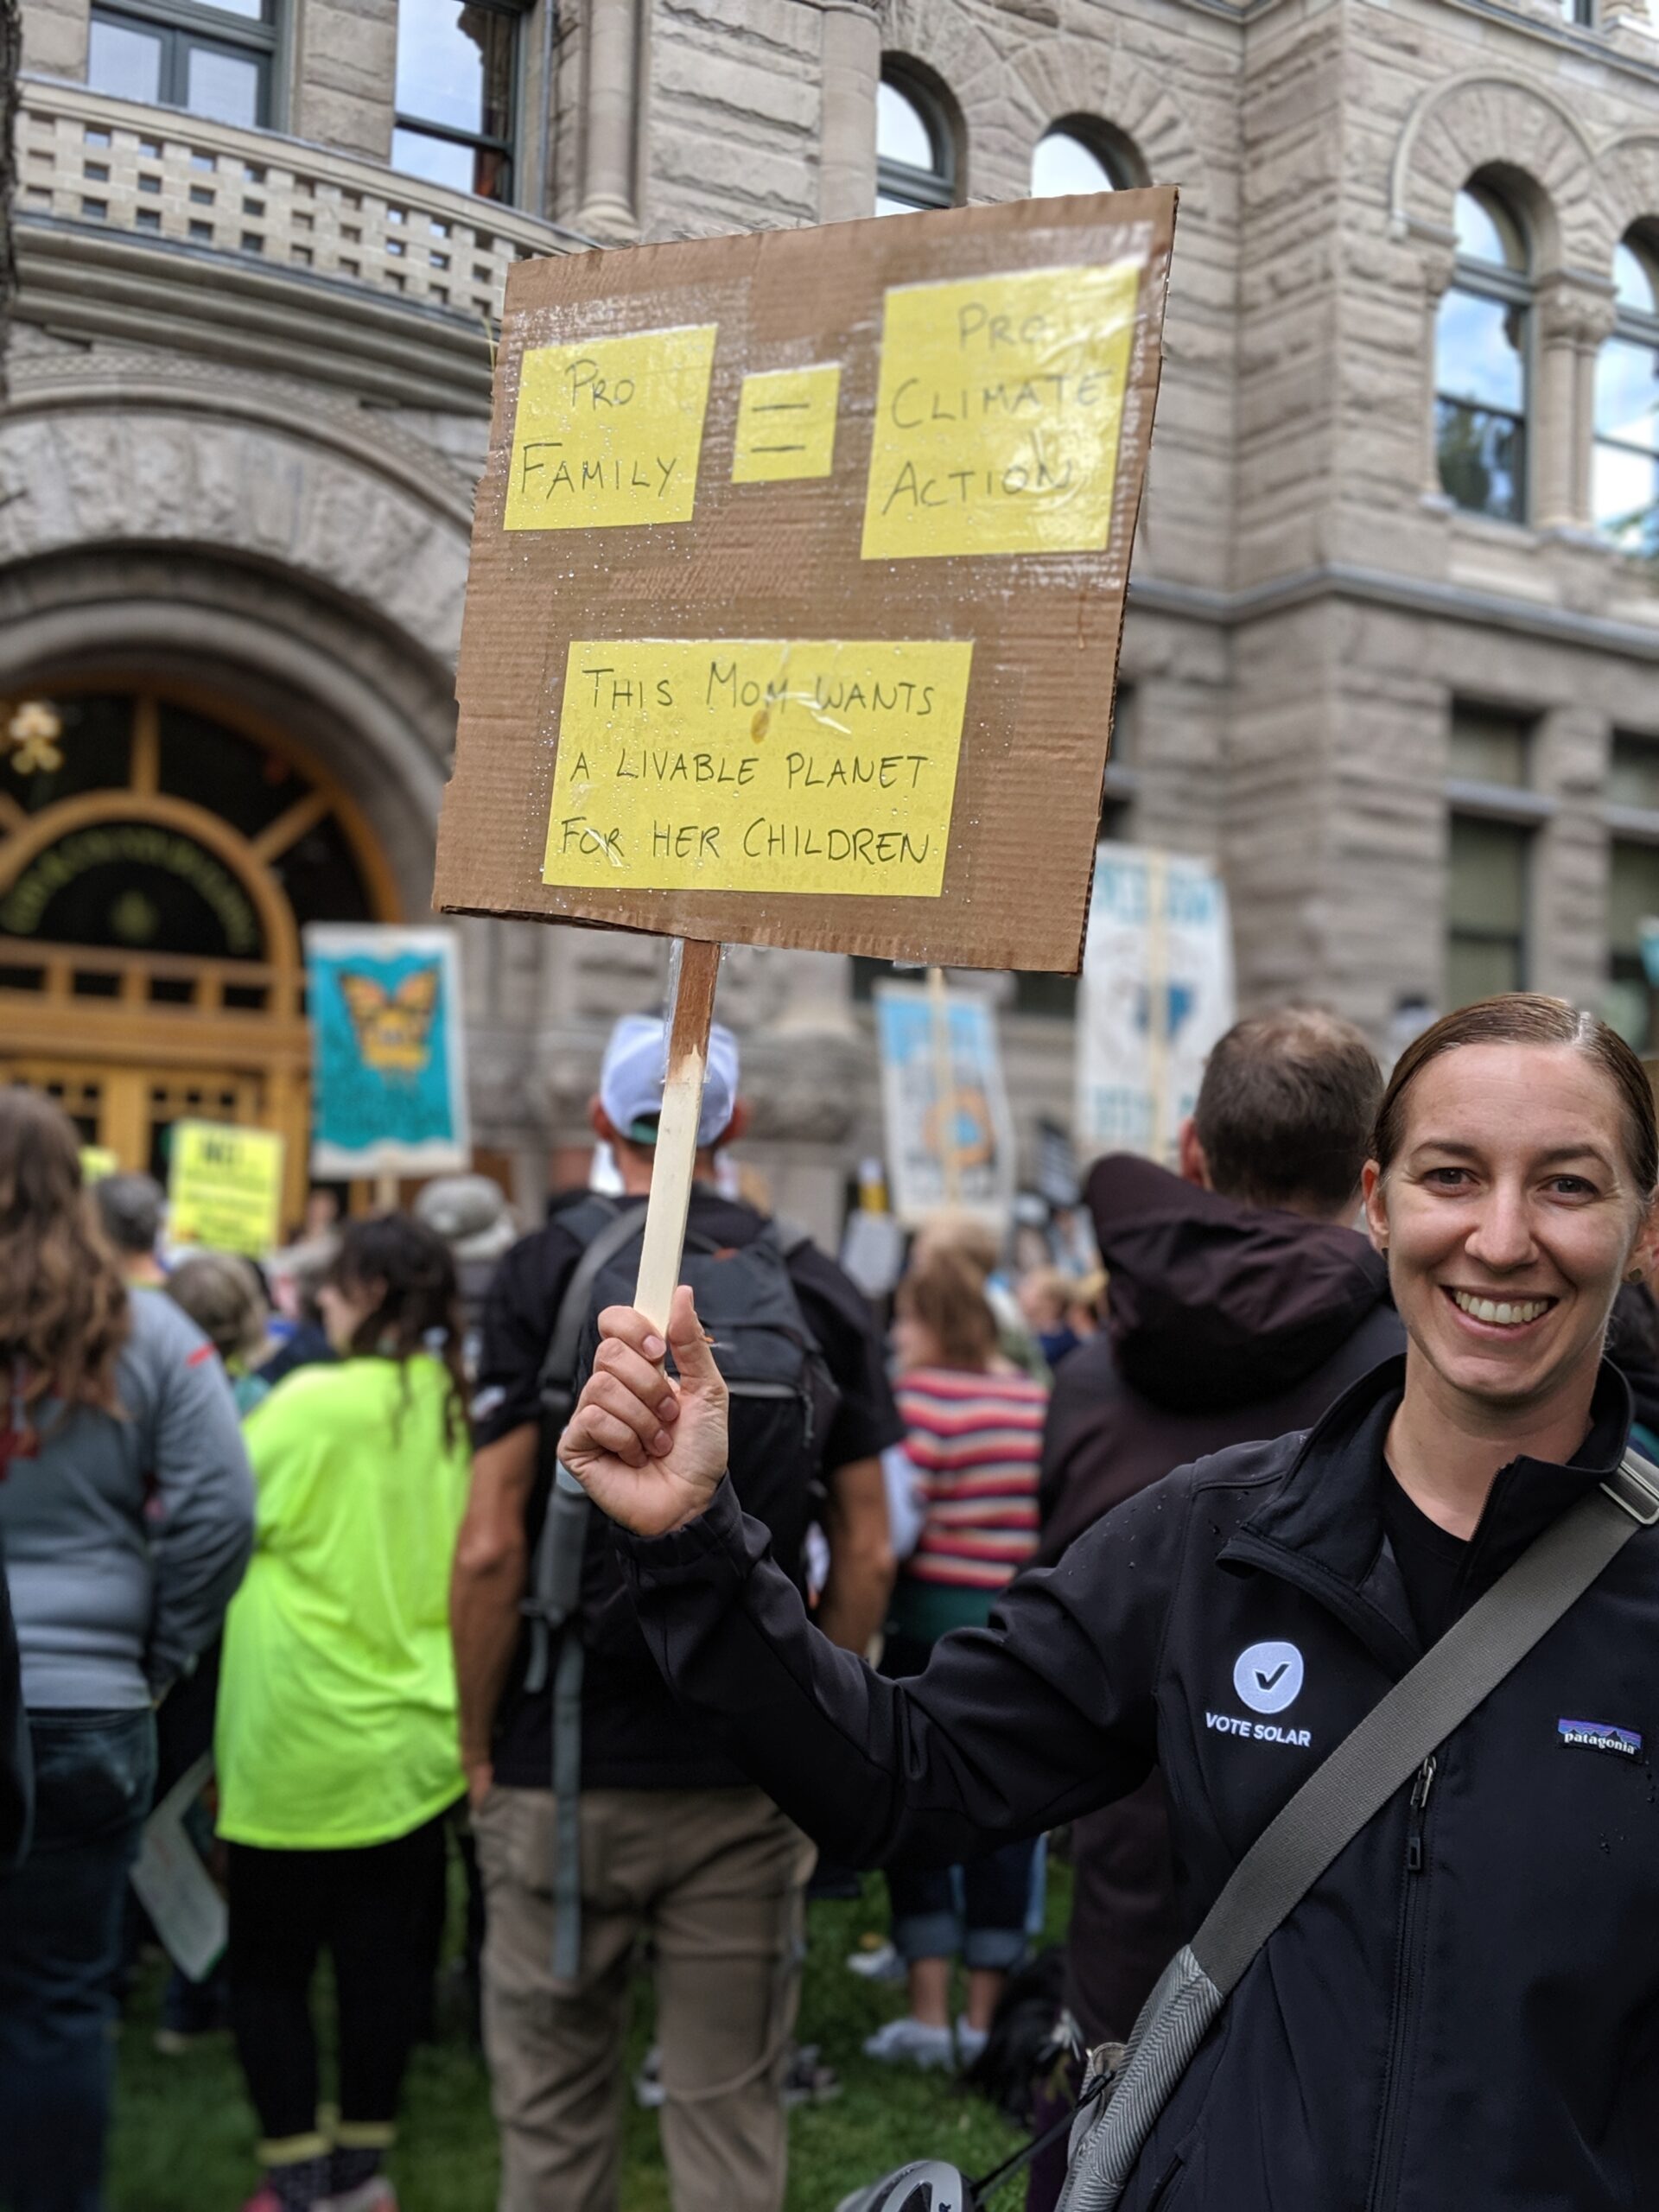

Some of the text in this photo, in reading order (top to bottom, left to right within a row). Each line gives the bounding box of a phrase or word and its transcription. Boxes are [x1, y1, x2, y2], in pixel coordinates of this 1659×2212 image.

[957, 302, 1049, 353] PRO
[564, 359, 635, 411] PRO
[891, 370, 1114, 429] CLIMATE
[521, 442, 677, 500] FAMILY
[881, 460, 1072, 516] ACTION
[582, 661, 936, 715] THIS MOM WANTS
[569, 748, 929, 790] A LIVABLE PLANET
[561, 816, 930, 865] FOR HER CHILDREN
[1205, 1712, 1312, 1748] VOTE SOLAR
[1563, 1732, 1636, 1755] patagonia
